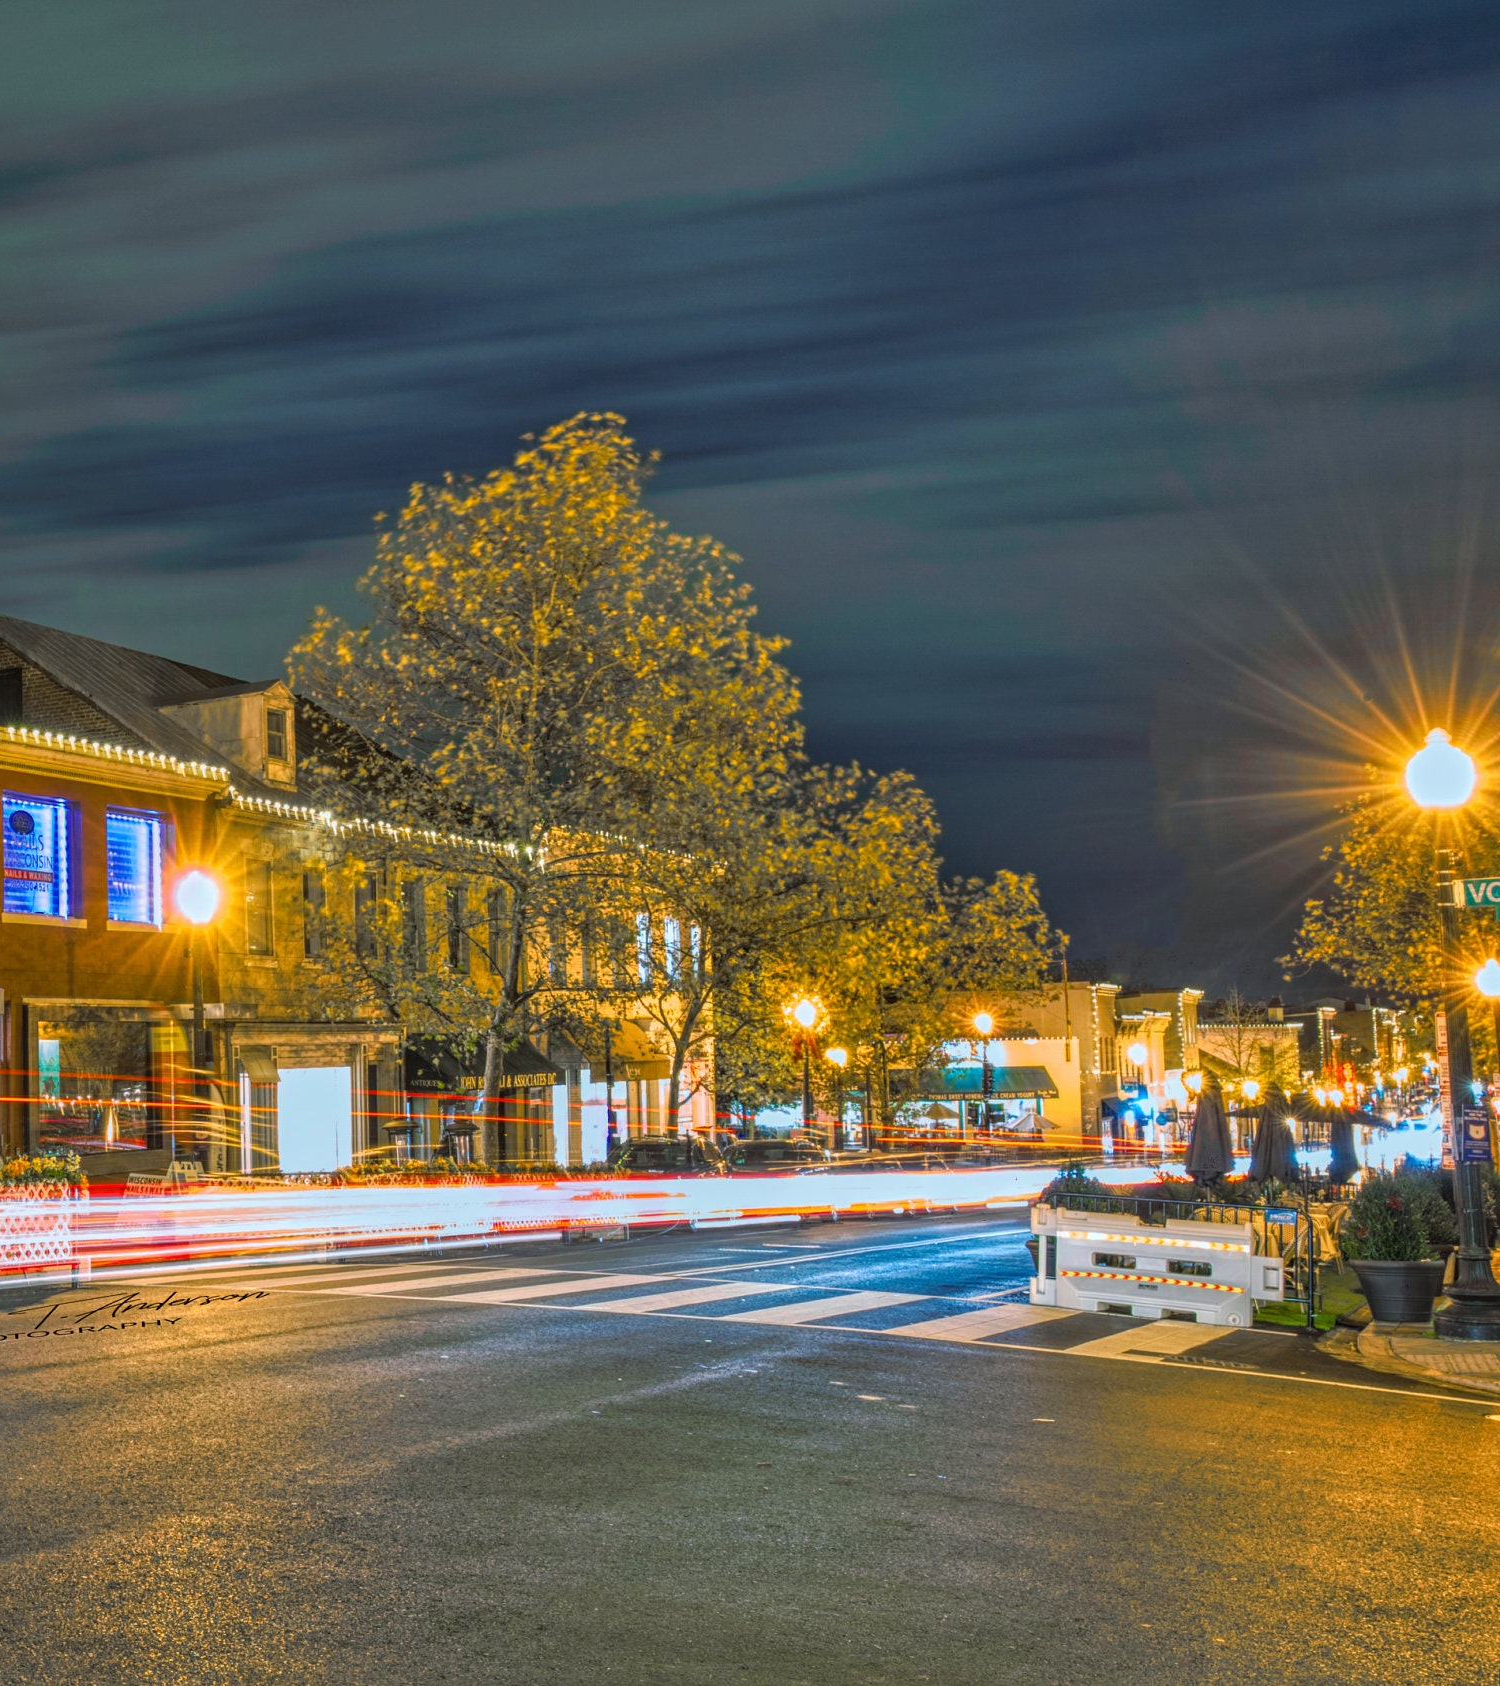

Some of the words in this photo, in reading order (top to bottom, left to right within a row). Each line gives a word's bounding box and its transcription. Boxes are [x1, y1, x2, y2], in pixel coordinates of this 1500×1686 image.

[410, 1079, 439, 1088] ANTIQUES
[460, 1075, 476, 1089] JOHN
[513, 1073, 547, 1088] ASSOCIATES
